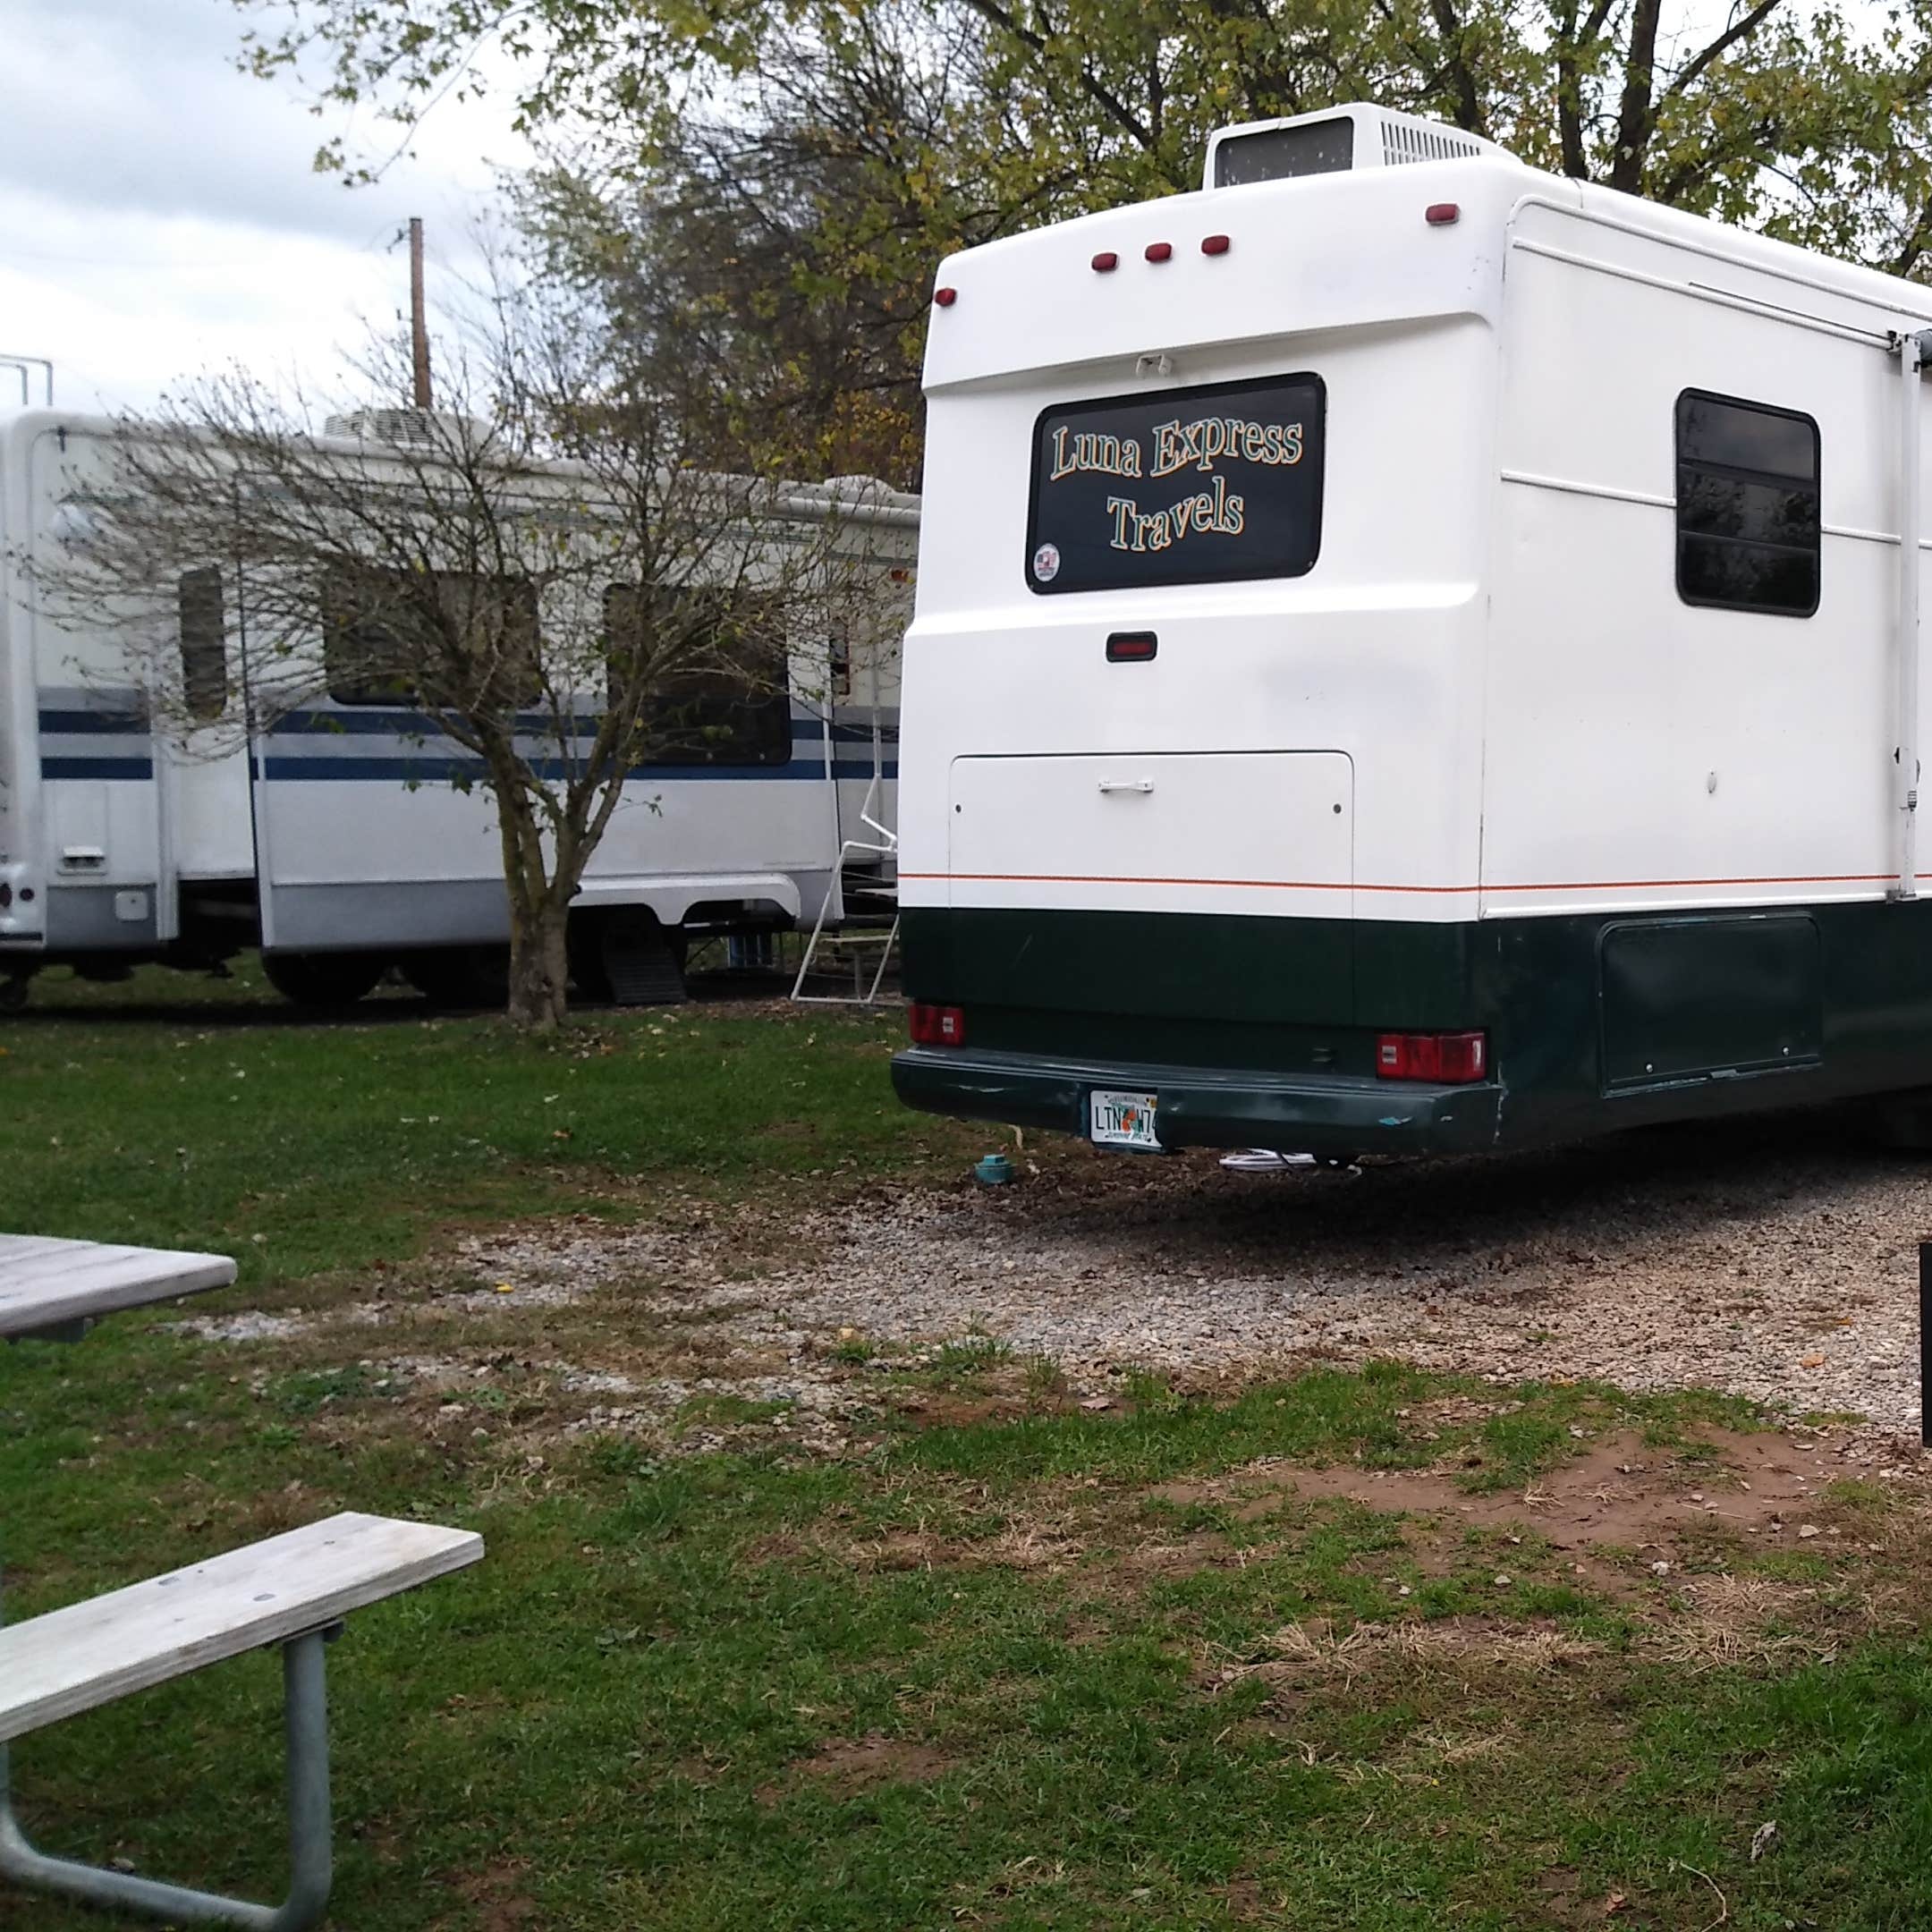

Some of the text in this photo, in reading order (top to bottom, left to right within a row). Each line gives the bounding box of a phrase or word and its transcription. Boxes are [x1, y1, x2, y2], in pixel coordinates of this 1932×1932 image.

[1051, 417, 1303, 480] Luna Express
[1107, 476, 1244, 551] Travels
